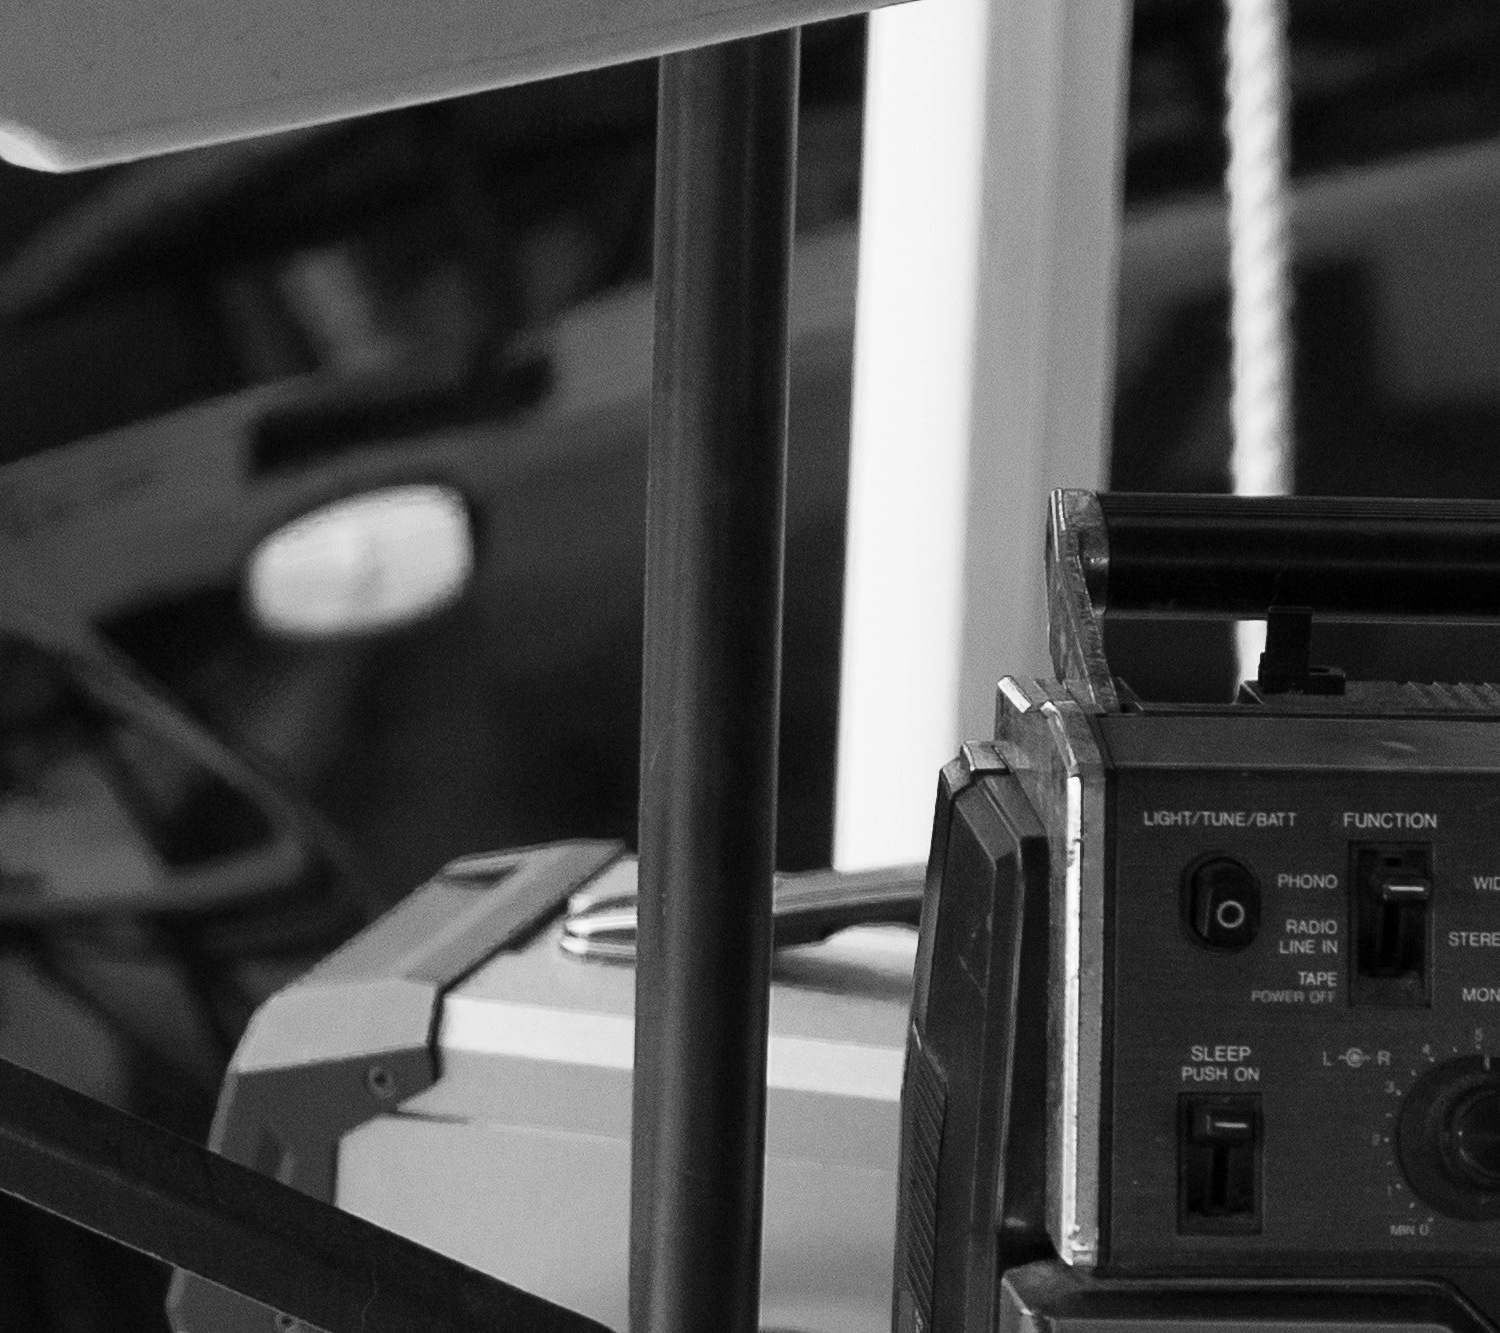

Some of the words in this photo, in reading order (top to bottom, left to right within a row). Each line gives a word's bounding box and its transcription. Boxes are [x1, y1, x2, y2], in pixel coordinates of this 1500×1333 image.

[1143, 811, 1297, 828] LIGHT/TUNE/BATT
[1342, 812, 1439, 829] FUNCTION
[1277, 874, 1339, 890] PHONO
[1284, 919, 1339, 935] RADIO
[1278, 940, 1315, 955] LINE
[1321, 940, 1339, 955] IN
[1297, 971, 1339, 988] TAPE
[1250, 989, 1304, 1003] POWER
[1309, 990, 1336, 1003] OFF
[1474, 1028, 1483, 1042] 5
[1190, 1046, 1252, 1063] SLEEP
[1422, 1043, 1431, 1055] 4
[1322, 1052, 1332, 1066] L
[1377, 1051, 1391, 1066] R
[1181, 1067, 1229, 1082] PUSH
[1233, 1067, 1260, 1082] ON
[1385, 1079, 1395, 1093] 3
[1390, 1224, 1415, 1236] MIN
